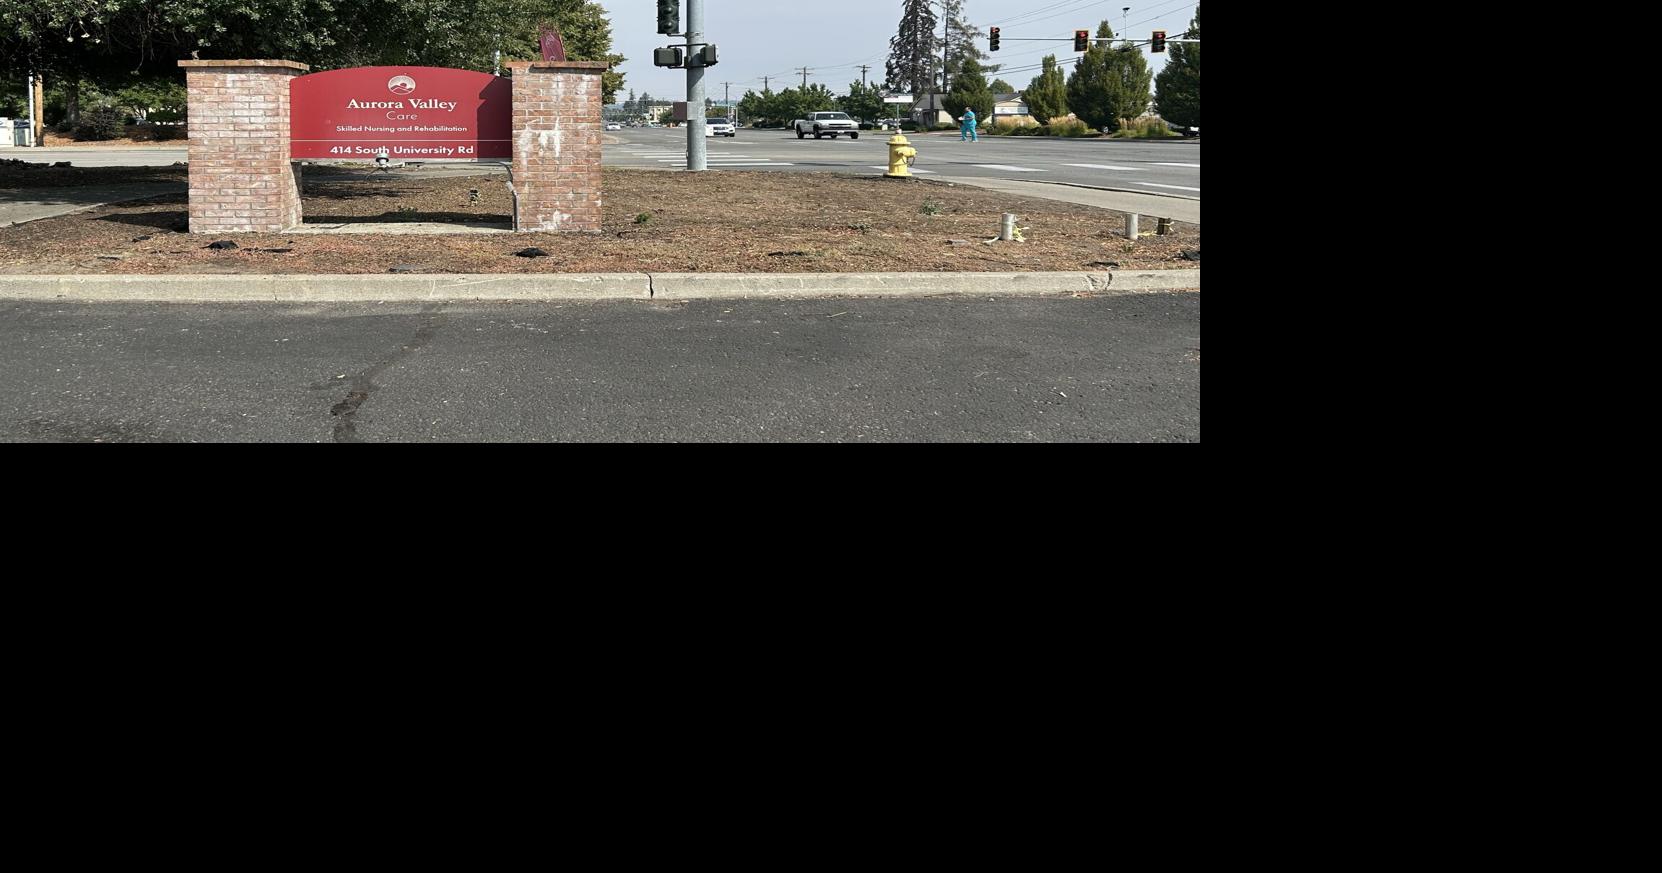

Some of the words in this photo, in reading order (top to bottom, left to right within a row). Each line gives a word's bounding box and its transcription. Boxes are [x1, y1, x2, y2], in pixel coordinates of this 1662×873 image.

[346, 98, 403, 108] Aurora
[408, 98, 457, 111] Valley
[386, 110, 417, 120] Care
[365, 125, 395, 133] Nursing
[330, 146, 351, 154] 414
[355, 145, 390, 154] South
[393, 146, 453, 156] University
[458, 146, 474, 154] Rd
